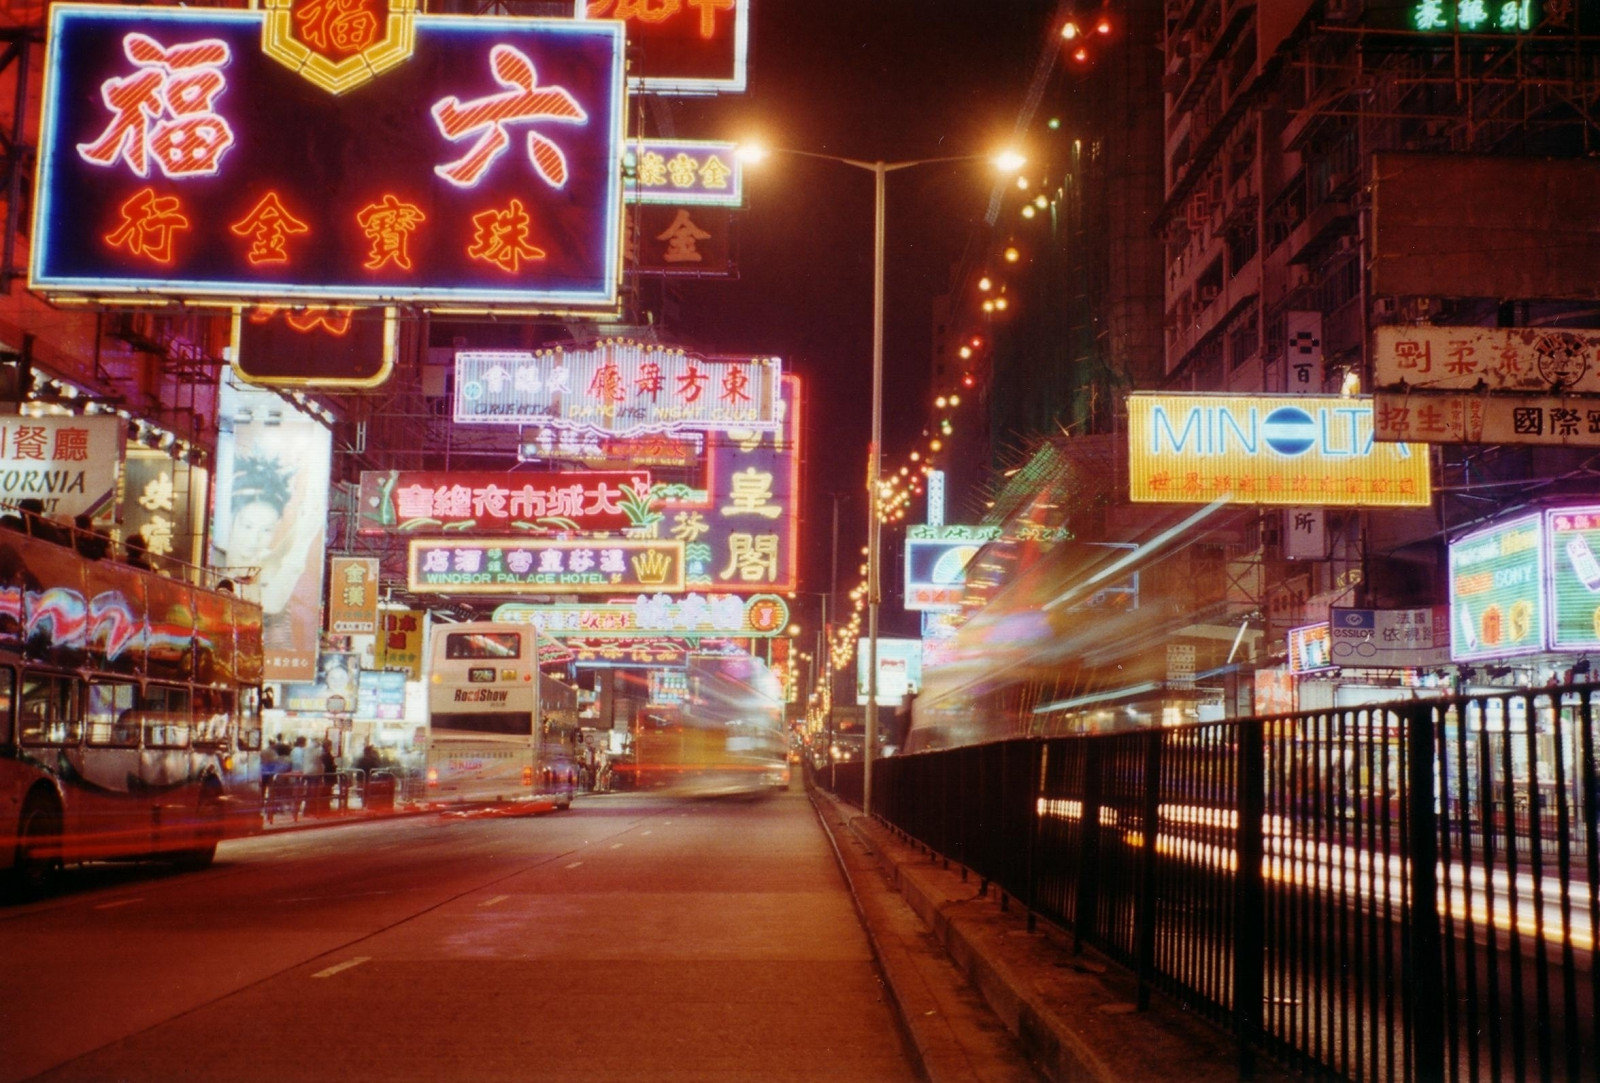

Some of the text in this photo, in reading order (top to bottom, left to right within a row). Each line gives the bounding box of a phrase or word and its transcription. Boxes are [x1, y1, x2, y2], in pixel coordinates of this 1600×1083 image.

[1, 426, 89, 462] 餐廳
[0, 471, 85, 494] ORNIA
[427, 574, 491, 584] WINDSOR
[497, 574, 555, 584] PALACE
[560, 574, 608, 584] HOTEL
